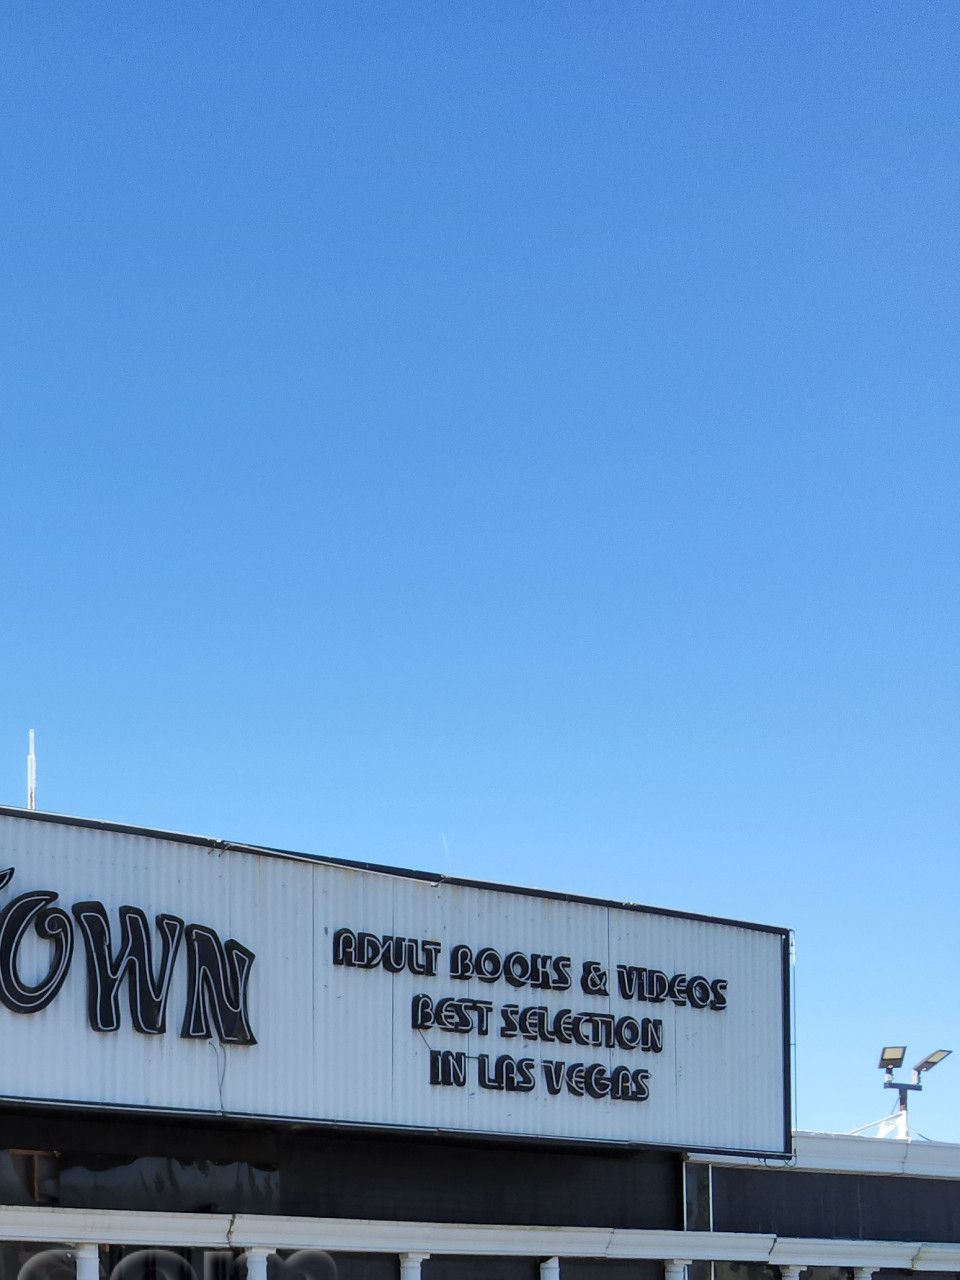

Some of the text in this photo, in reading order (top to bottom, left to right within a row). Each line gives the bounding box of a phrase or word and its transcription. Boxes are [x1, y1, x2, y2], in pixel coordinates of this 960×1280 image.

[333, 928, 728, 1011] ADULT BOOKS & VIDEOS
[411, 993, 663, 1053] BEST SELECTION
[430, 1050, 651, 1101] IN LAS VEGAS
